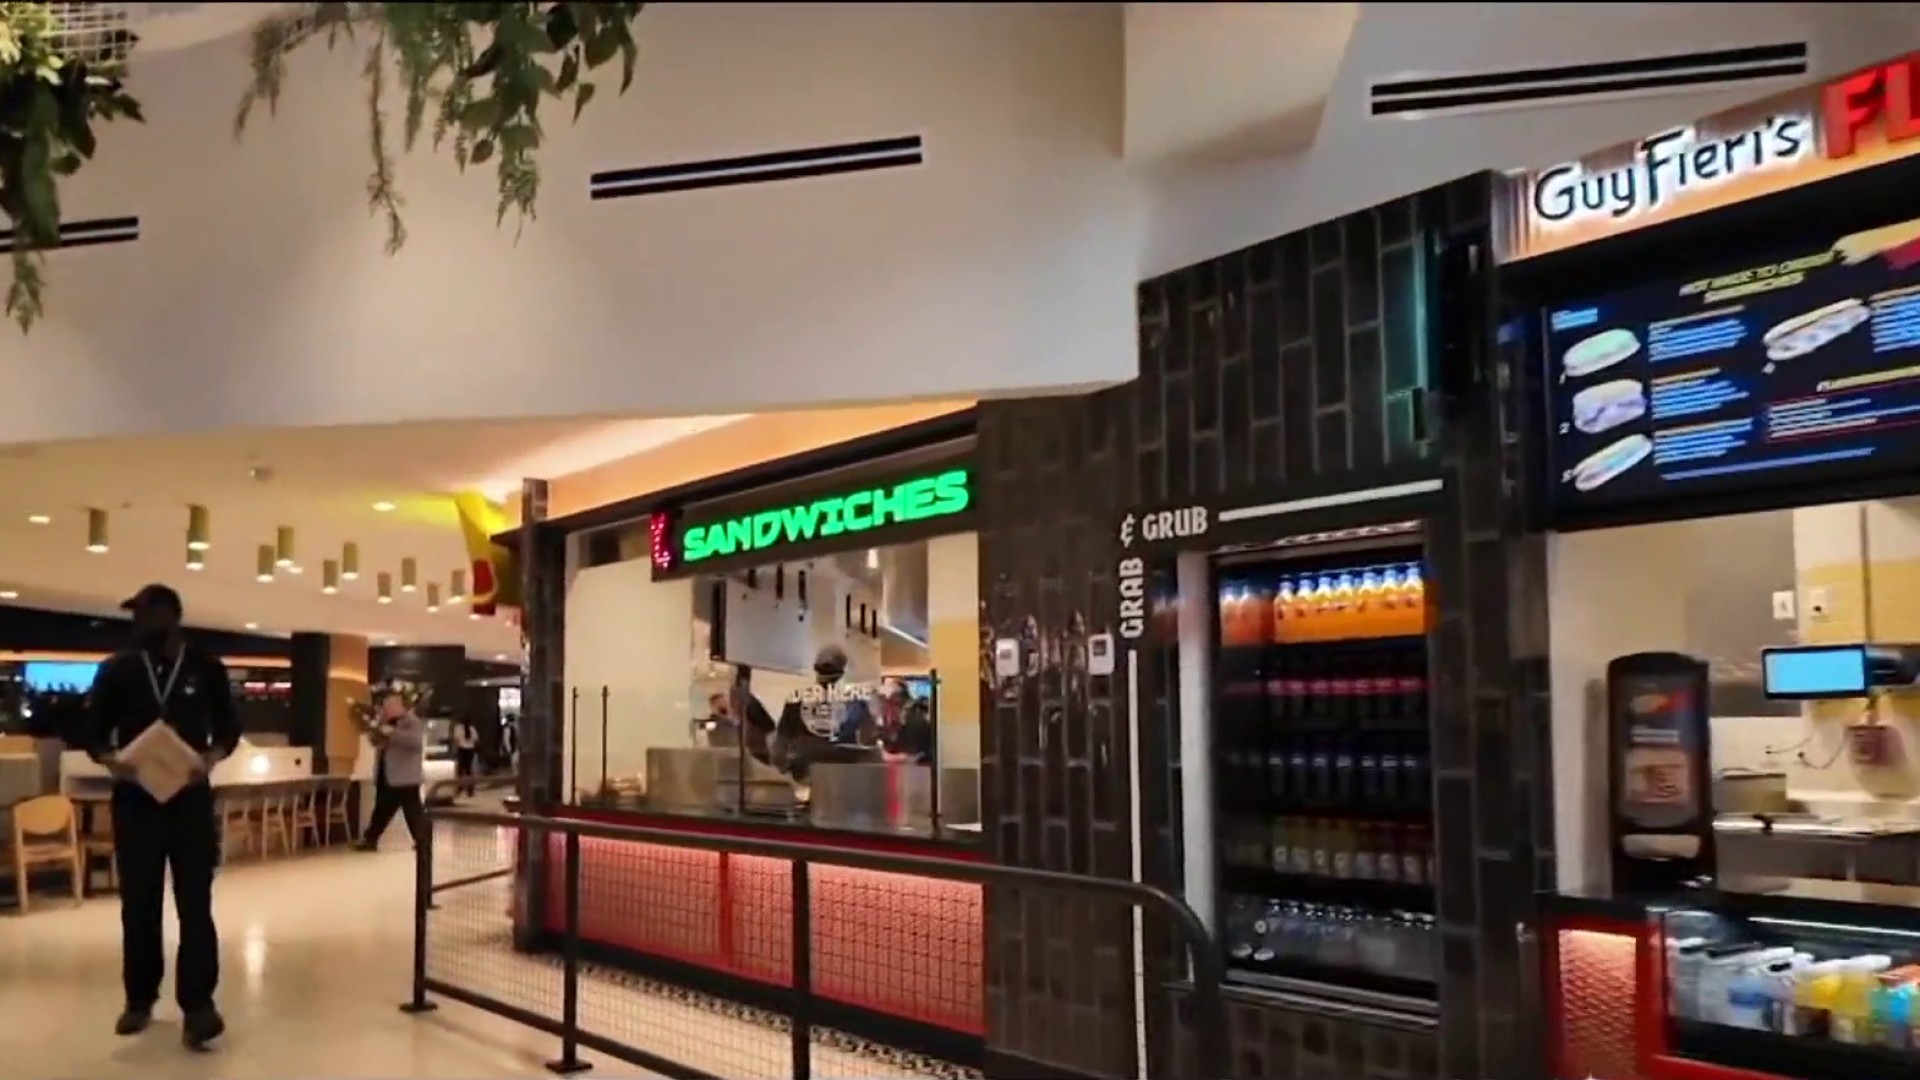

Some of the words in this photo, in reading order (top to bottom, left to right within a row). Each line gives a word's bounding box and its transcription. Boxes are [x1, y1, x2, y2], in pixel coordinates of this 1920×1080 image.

[683, 470, 969, 561] SANDWICHES
[1119, 557, 1144, 639] GRAB
[1142, 505, 1208, 541] GRUB
